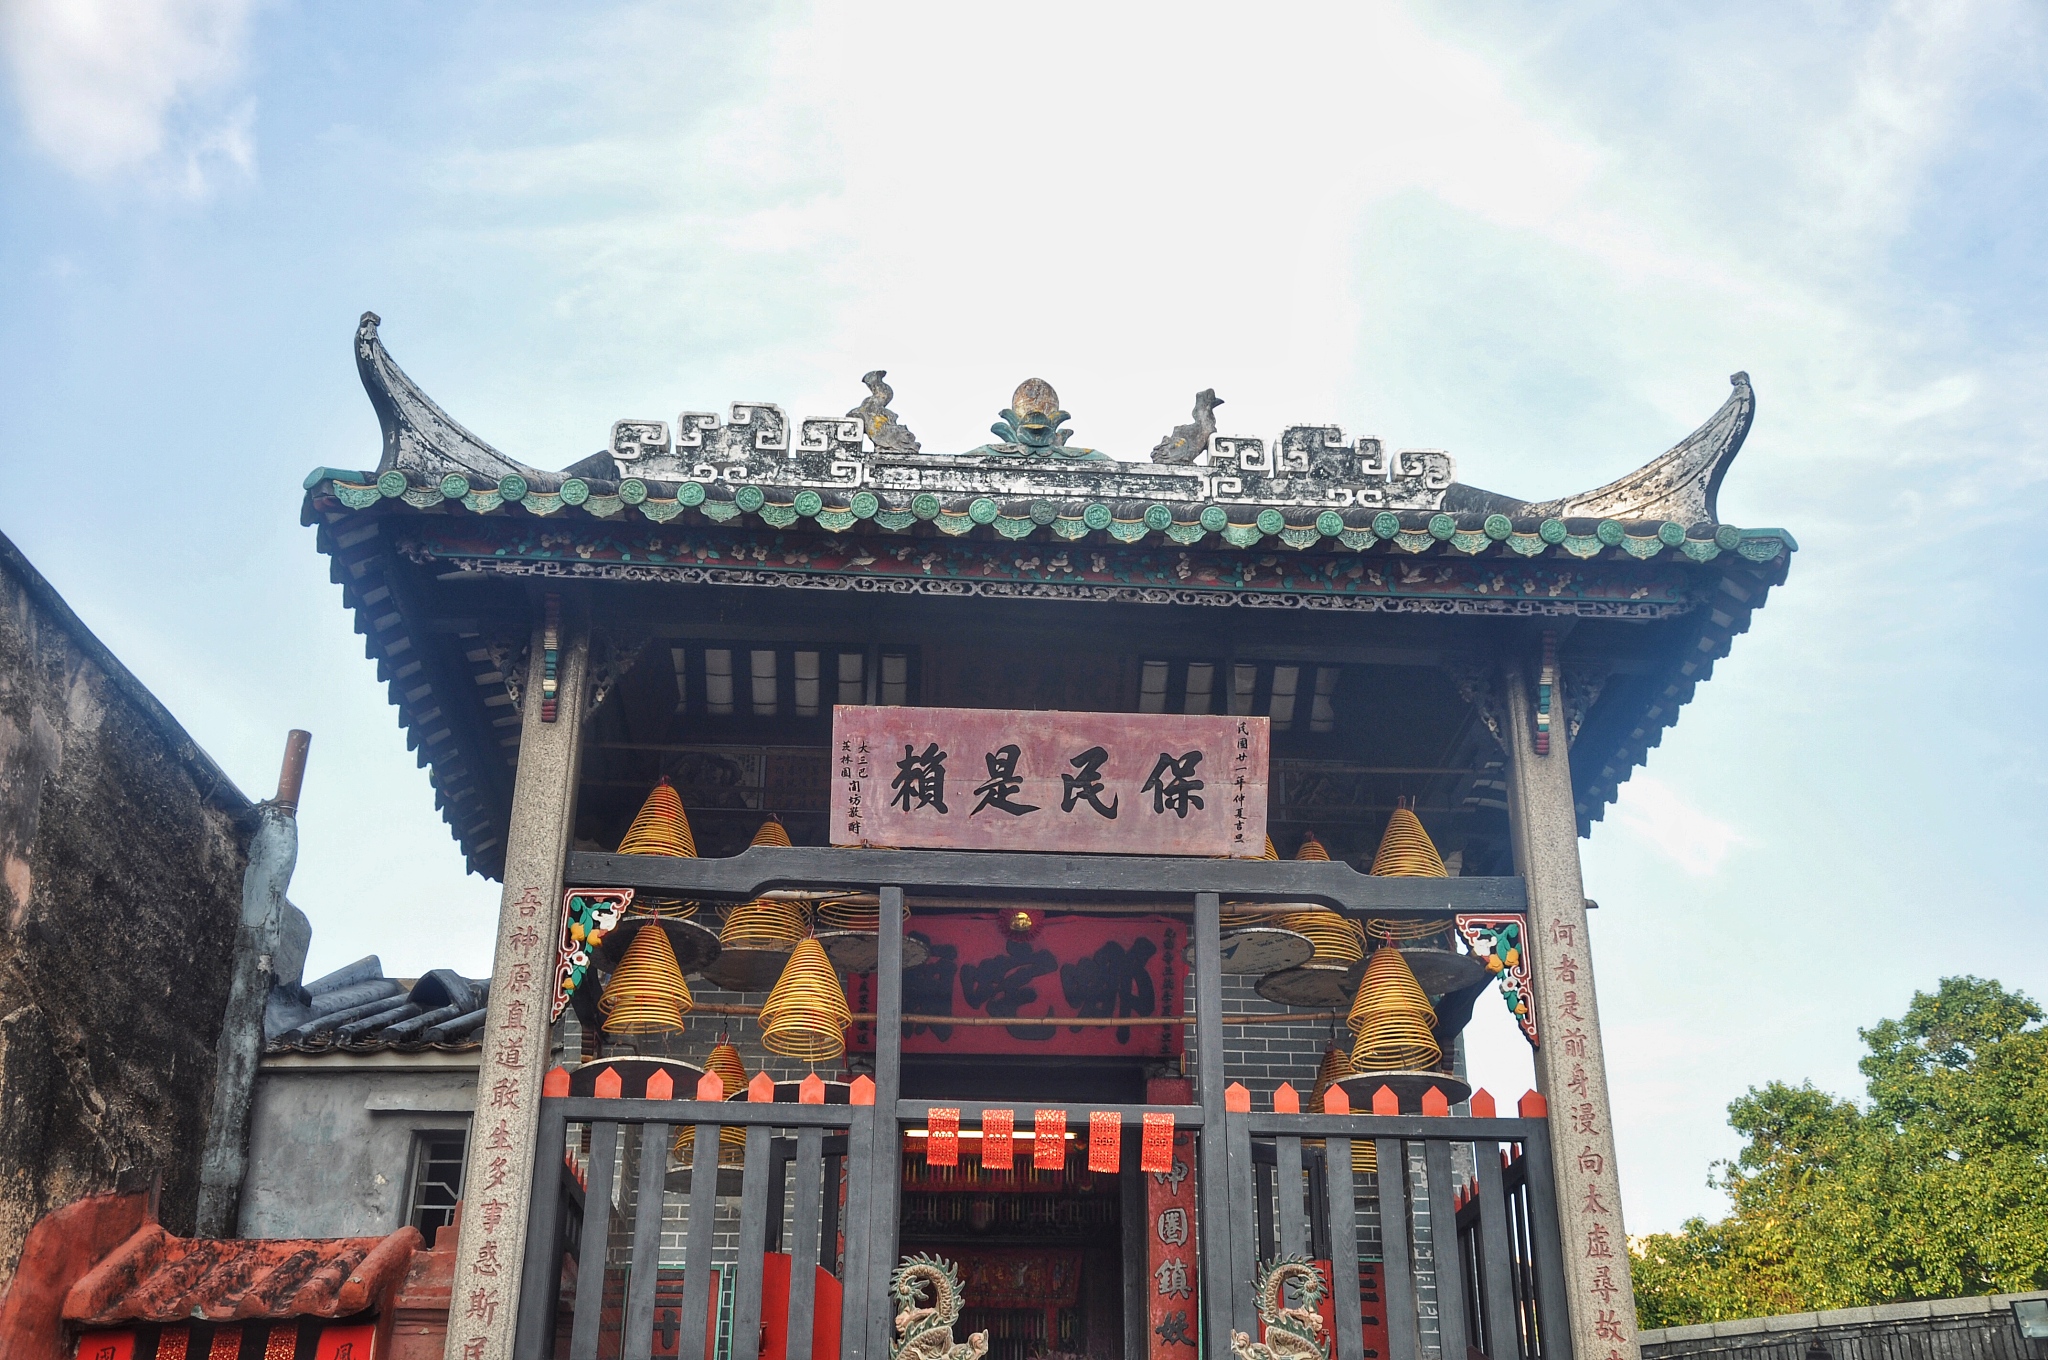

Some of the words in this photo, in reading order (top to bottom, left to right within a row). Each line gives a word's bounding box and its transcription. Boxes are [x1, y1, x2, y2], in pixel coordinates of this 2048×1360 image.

[857, 740, 870, 778] 大三巴
[891, 742, 1205, 819] 保民是賴
[1550, 918, 1627, 1360] 何者是前身漫向太虛尋故
